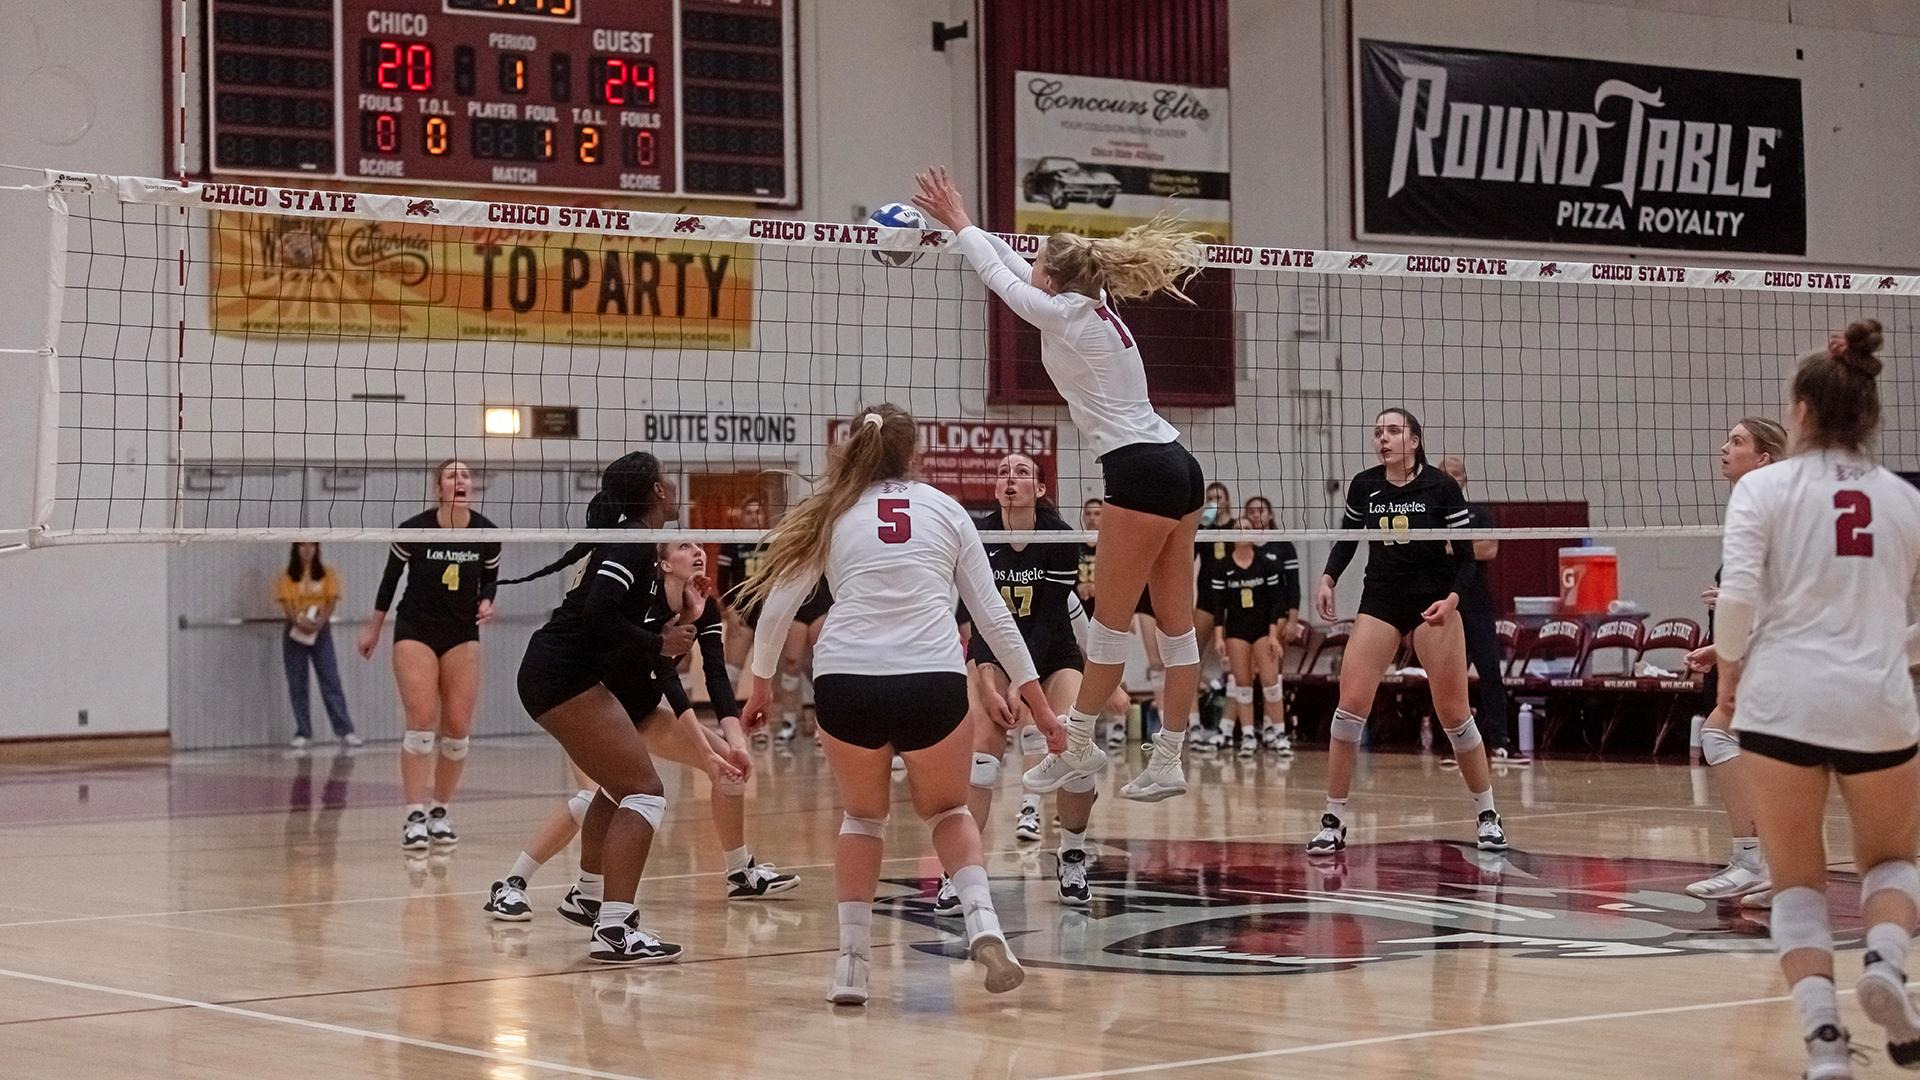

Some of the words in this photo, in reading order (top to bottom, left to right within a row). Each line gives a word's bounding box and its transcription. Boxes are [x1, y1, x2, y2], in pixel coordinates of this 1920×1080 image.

[367, 10, 428, 36] CHICO
[489, 33, 537, 51] PERIOD
[593, 29, 653, 54] GUEST
[378, 42, 431, 90] 20
[515, 59, 524, 90] 1
[605, 59, 655, 104] 24
[359, 94, 403, 112] FOULS
[418, 98, 455, 116] T.O.L.
[467, 102, 518, 119] PLAYER
[525, 105, 559, 122] FOUL
[1029, 78, 1148, 114] Concours
[1153, 89, 1210, 122] Elite
[572, 108, 607, 125] T.O.L.
[620, 111, 661, 129] FOULS
[377, 115, 395, 151] 0
[426, 117, 447, 154] 0
[545, 128, 552, 157] 1
[579, 127, 599, 163] 2
[1387, 63, 1600, 198] ROUND
[1595, 79, 1776, 208] TABLE
[359, 158, 404, 176] SCORE
[492, 166, 537, 183] MATCH
[619, 173, 661, 191] SCORE
[200, 184, 268, 207] CHICO
[278, 189, 357, 212] STATE
[488, 203, 550, 225] CHICO
[558, 208, 631, 230] STATE
[1557, 201, 1625, 230] PIZZA
[1638, 207, 1744, 237] ROYALTY
[749, 219, 806, 241] CHICO
[813, 223, 879, 244] STATE
[1206, 246, 1253, 264] CHICO
[1259, 249, 1315, 267] STATE
[1406, 255, 1450, 273] CHICO
[1456, 258, 1508, 276] STATE
[474, 244, 537, 314] TO
[561, 248, 731, 318] PARTY
[1592, 264, 1633, 281] CHICO
[1638, 266, 1686, 283] STATE
[1764, 272, 1802, 287] CHICO
[1807, 273, 1851, 289] STATE
[645, 414, 707, 441] BUTTE
[715, 415, 796, 443] STRONG
[914, 424, 1052, 455] ILDCATS!
[1369, 502, 1385, 514] Los
[1386, 501, 1426, 514] Angeles
[877, 498, 912, 544] 5
[1833, 490, 1874, 557] 2
[426, 549, 444, 560] Los
[444, 550, 480, 563] Angeles
[442, 563, 460, 591] 4
[992, 569, 1006, 580] os
[1006, 567, 1046, 584] Angele
[1562, 567, 1575, 588] G
[1000, 586, 1034, 618] 17
